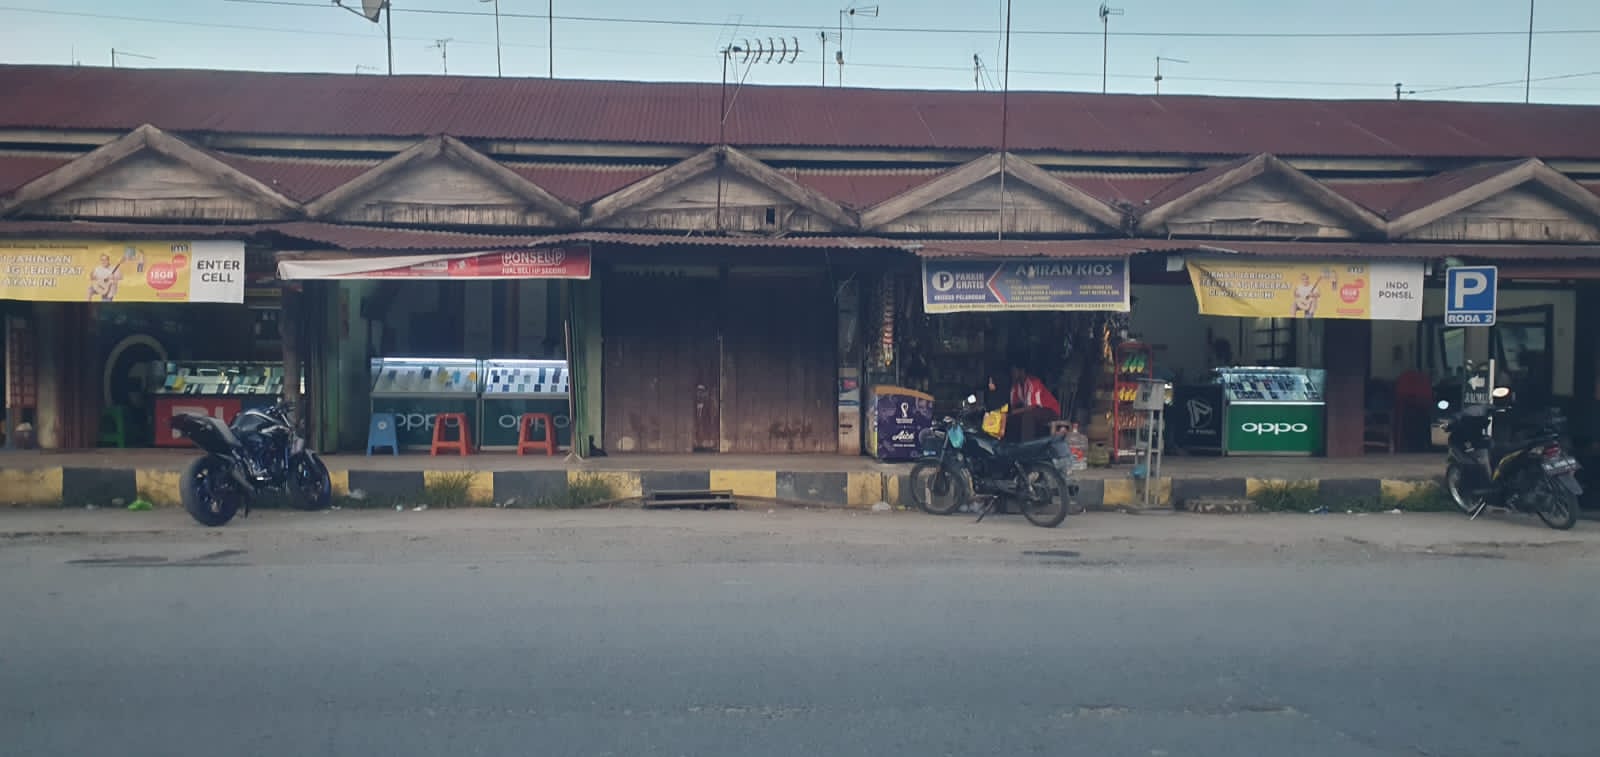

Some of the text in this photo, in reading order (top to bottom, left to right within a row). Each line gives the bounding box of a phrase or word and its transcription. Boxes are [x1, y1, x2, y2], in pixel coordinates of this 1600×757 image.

[197, 259, 241, 271] ENTER
[1077, 263, 1113, 276] KIOS
[201, 271, 235, 283] CELL
[955, 280, 985, 289] GRATIS
[1385, 281, 1409, 290] INDO
[1455, 271, 1488, 309] P
[1378, 290, 1415, 300] PONSEL
[1448, 314, 1493, 323] RODA 2
